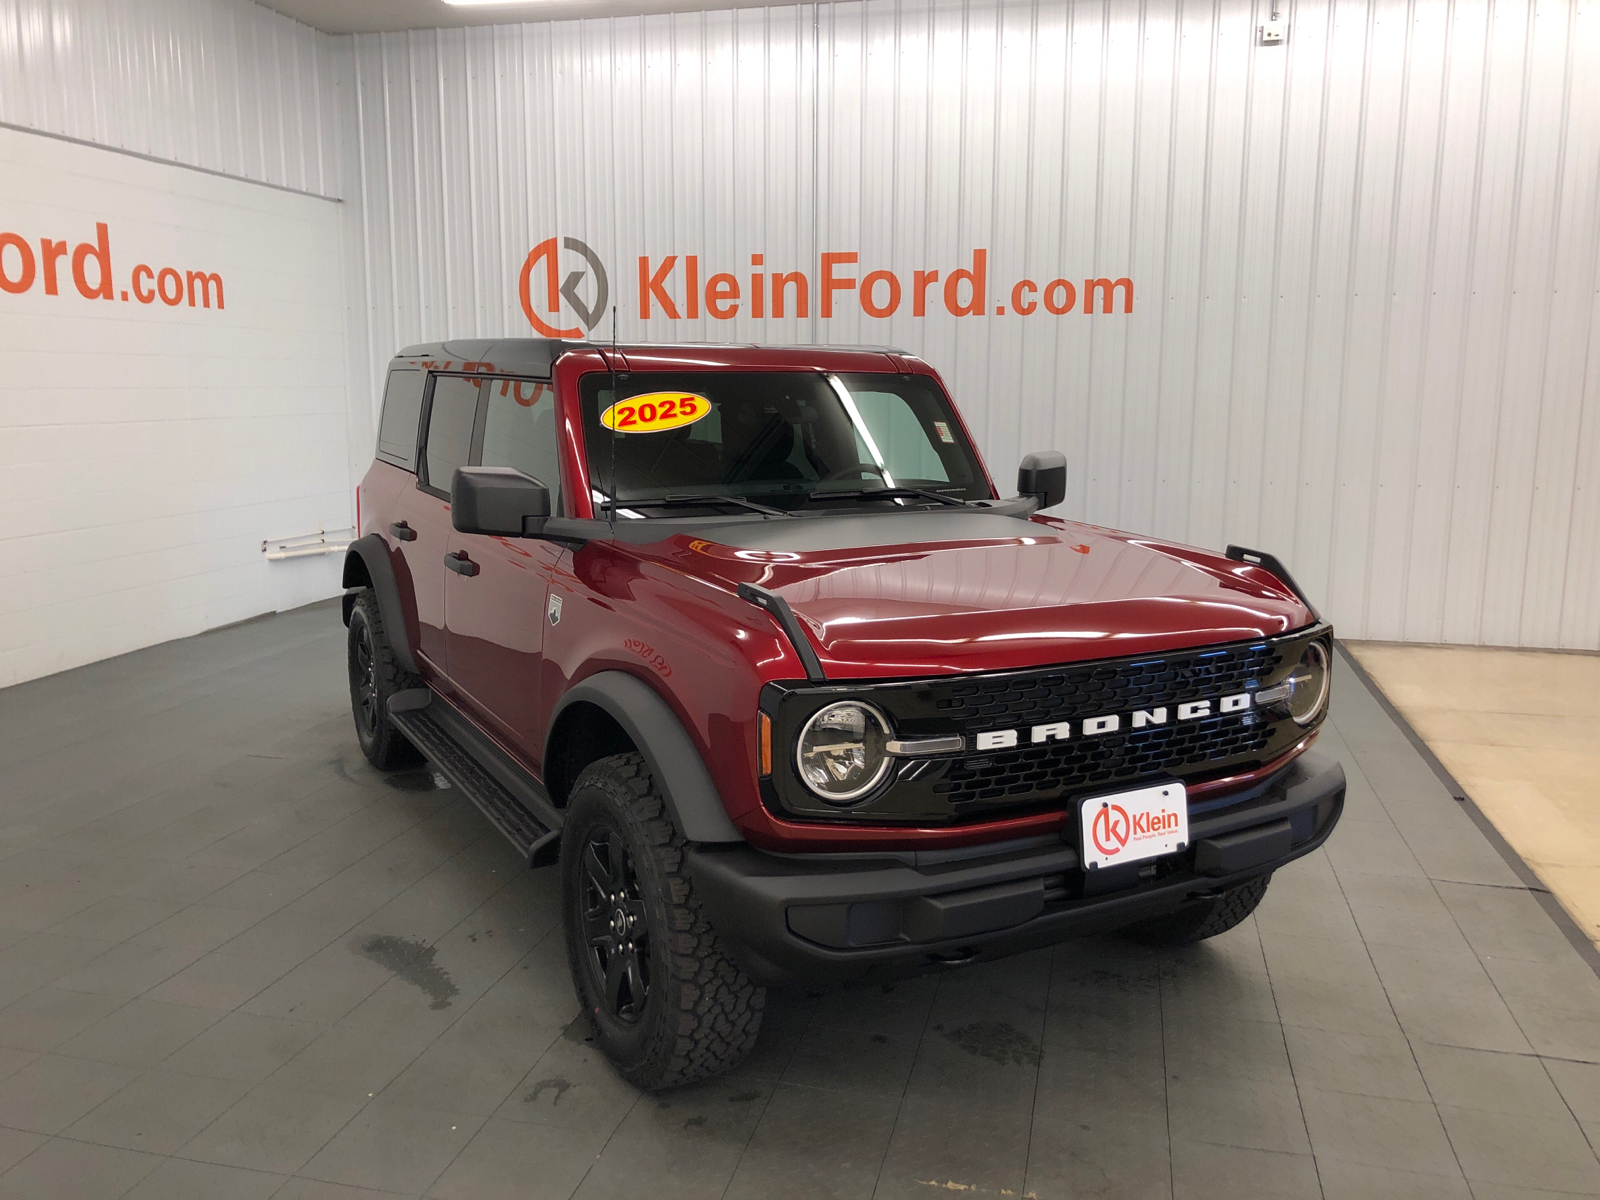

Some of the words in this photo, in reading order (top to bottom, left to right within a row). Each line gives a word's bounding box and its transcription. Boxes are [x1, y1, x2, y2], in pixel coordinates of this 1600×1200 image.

[638, 248, 1134, 319] KleinFord.com
[617, 396, 697, 427] 2025
[976, 692, 1250, 750] BRONCO
[1132, 809, 1179, 835] Klein
